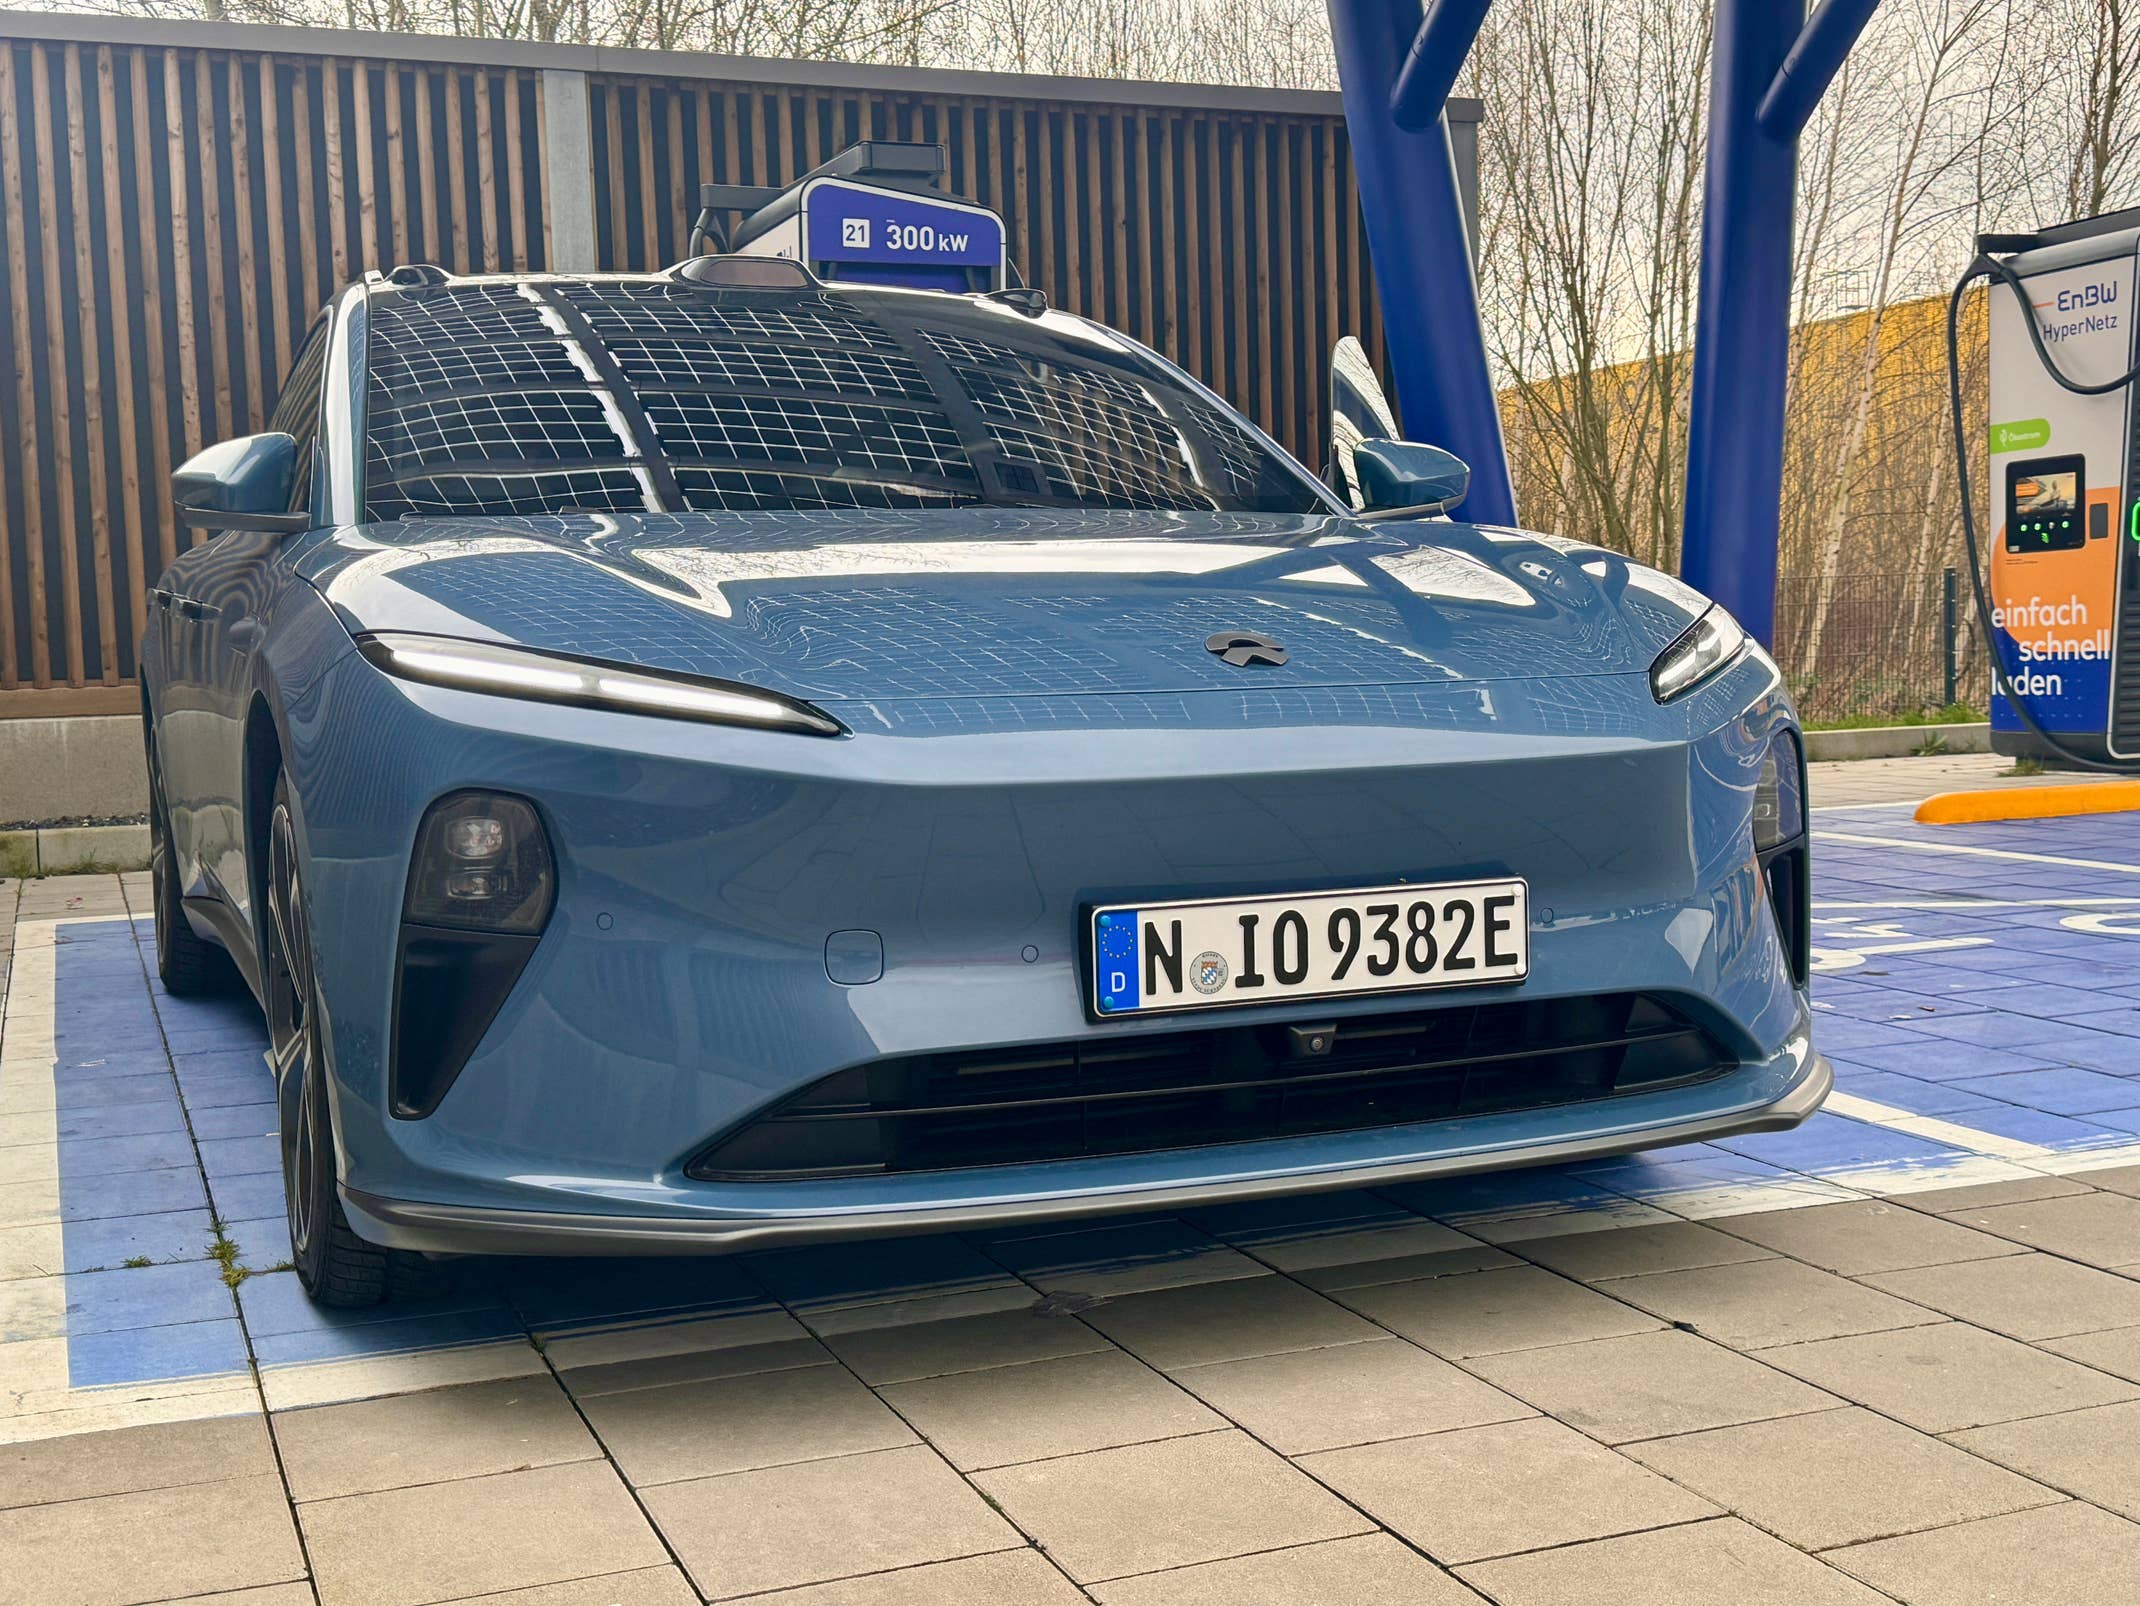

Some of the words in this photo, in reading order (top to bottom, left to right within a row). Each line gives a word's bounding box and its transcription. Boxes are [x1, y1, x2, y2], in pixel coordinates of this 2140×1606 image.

[845, 224, 866, 242] 21
[886, 225, 935, 251] 300
[938, 234, 969, 252] kW
[2061, 281, 2117, 311] EnBW
[2043, 316, 2118, 342] HyperNetz
[1991, 595, 2087, 627] einfach
[2019, 629, 2109, 661] schnell
[1144, 920, 1183, 995] N
[1235, 909, 1309, 988] IO
[1327, 896, 1518, 981] 9382E
[1111, 972, 1126, 993] D
